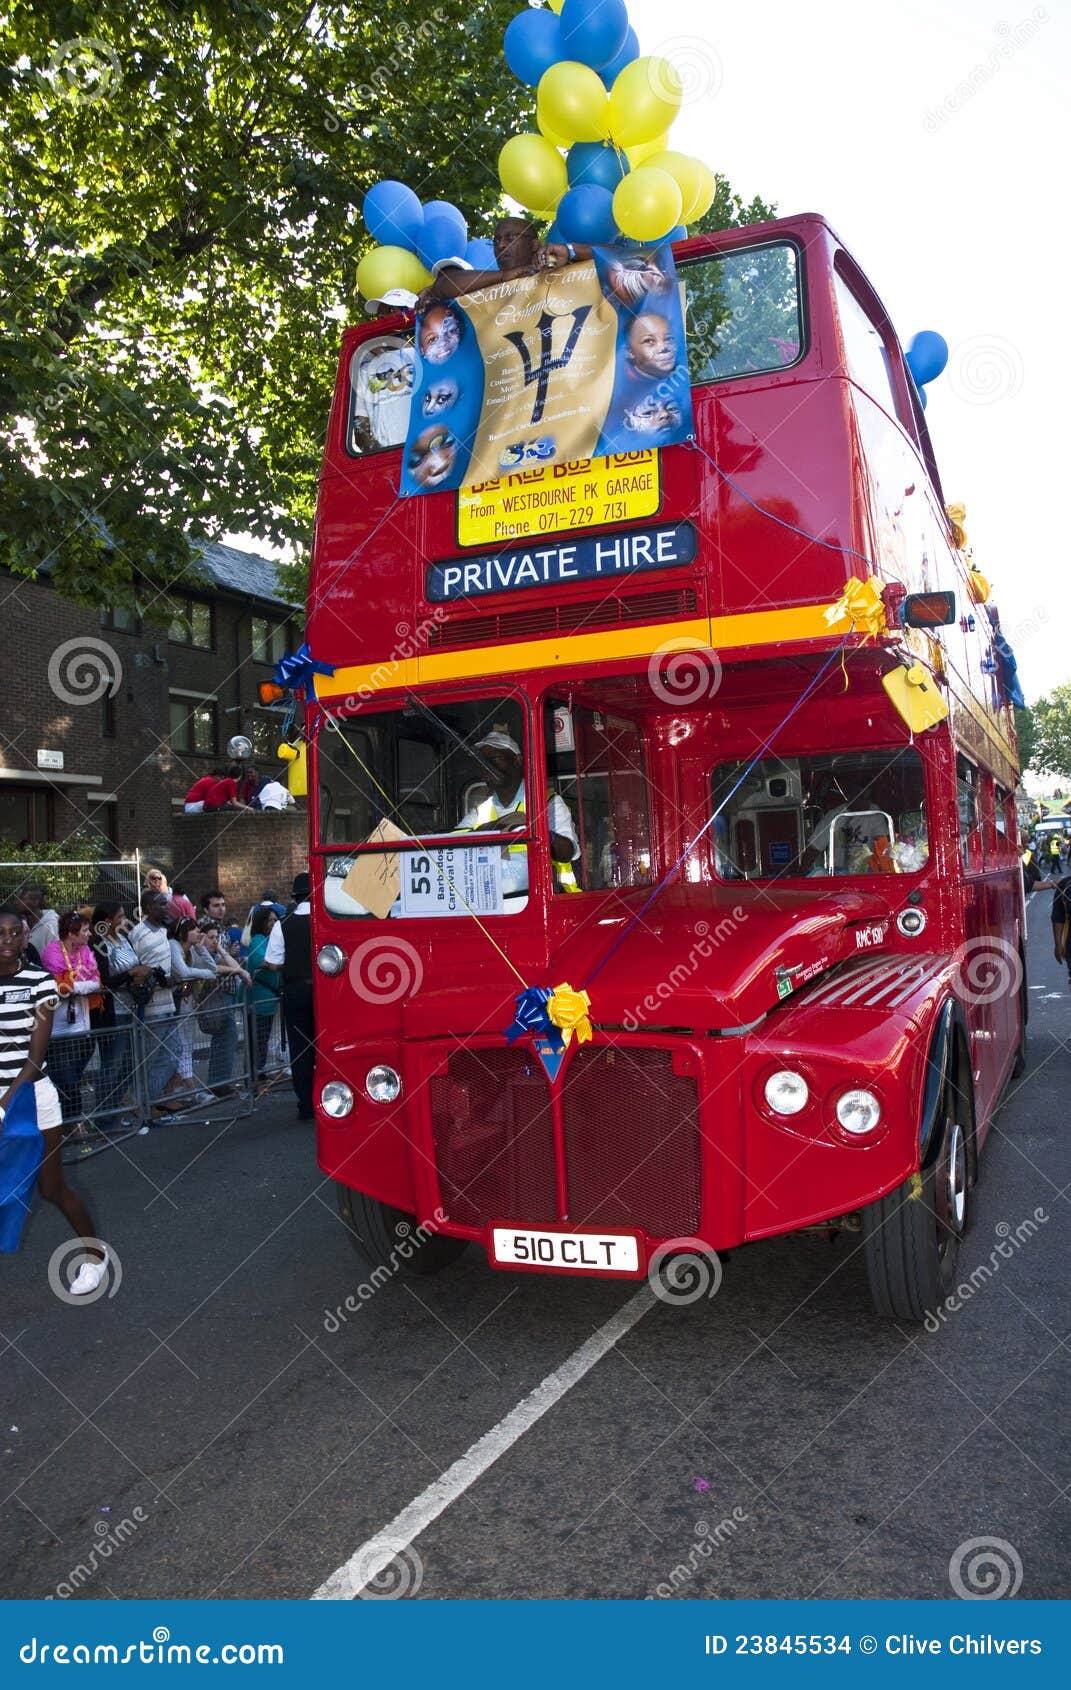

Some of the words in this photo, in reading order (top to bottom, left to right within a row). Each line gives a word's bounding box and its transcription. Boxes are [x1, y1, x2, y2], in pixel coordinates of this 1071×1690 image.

[470, 504, 495, 519] From
[502, 486, 576, 513] WESTBOURNE
[584, 482, 599, 500] PK
[607, 473, 653, 496] GARAGE
[494, 521, 530, 537] Phone
[539, 506, 594, 531] 071-229
[603, 501, 627, 520] 7131
[443, 547, 578, 596] PRIVATE
[595, 530, 678, 572] HIRE
[411, 856, 431, 895] 55
[855, 928, 872, 948] RMC
[513, 1236, 554, 1262] 510
[560, 1239, 616, 1266] CLT
